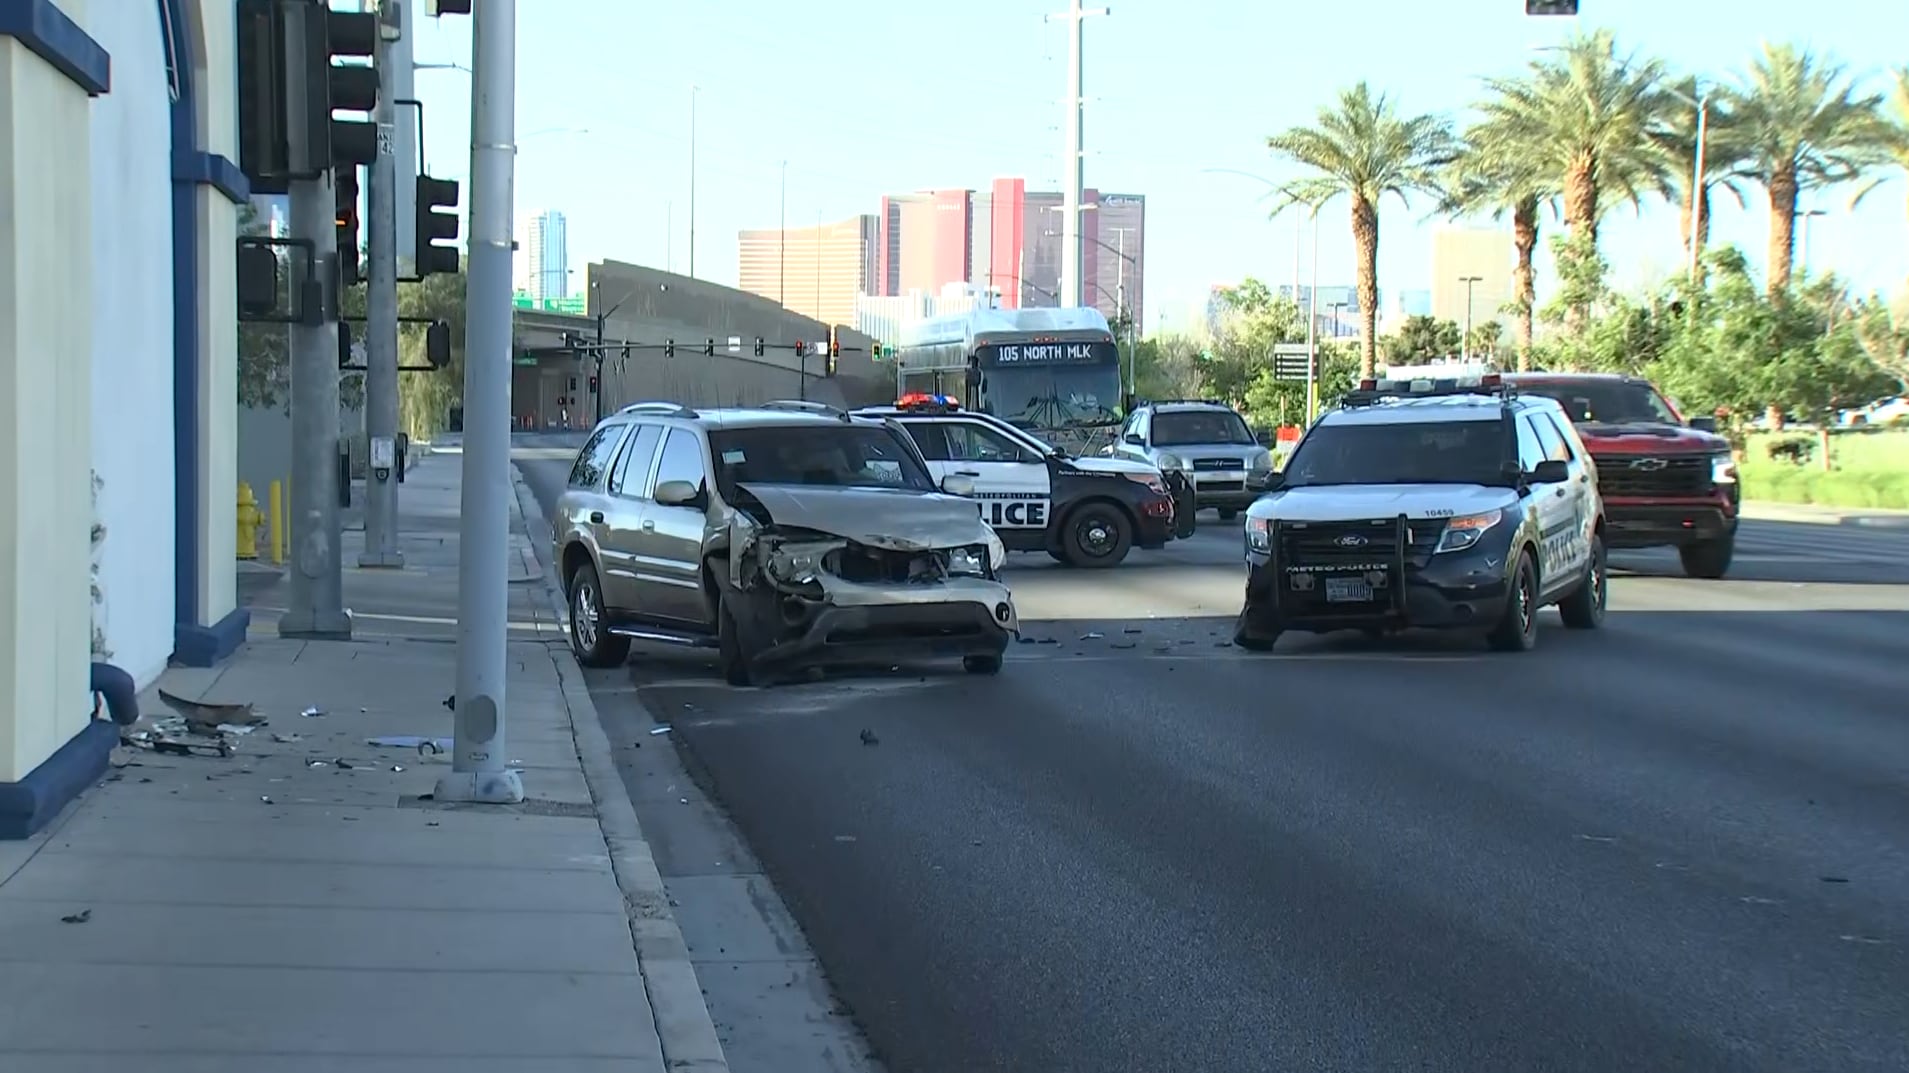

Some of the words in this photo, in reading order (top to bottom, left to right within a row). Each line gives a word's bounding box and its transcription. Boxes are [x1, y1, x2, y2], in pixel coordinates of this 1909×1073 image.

[999, 346, 1018, 361] 105
[1023, 345, 1062, 360] NORTH
[1067, 344, 1091, 358] MLK
[977, 503, 1044, 525] LICE
[1337, 563, 1388, 571] POLICE
